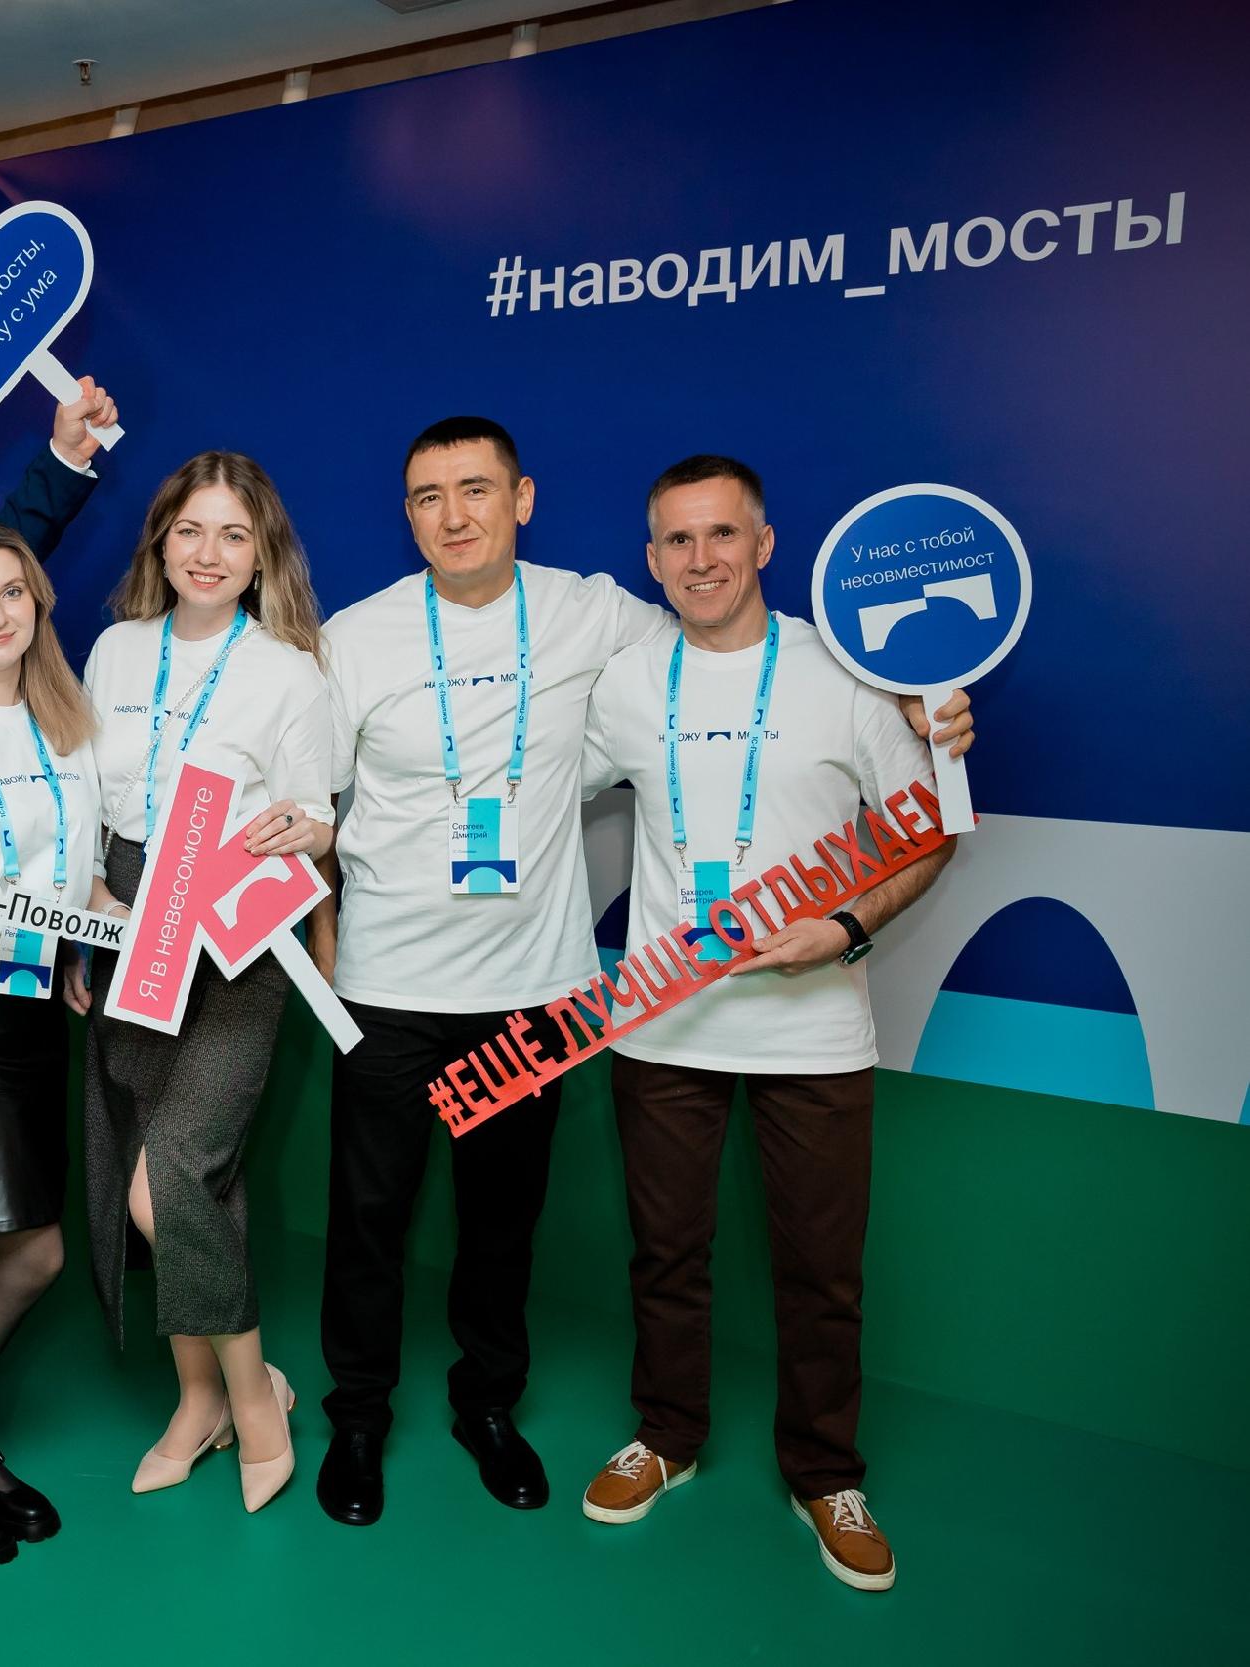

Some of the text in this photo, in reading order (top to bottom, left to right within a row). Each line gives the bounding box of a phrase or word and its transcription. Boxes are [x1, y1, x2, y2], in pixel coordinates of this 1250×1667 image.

[486, 191, 1186, 317] #наводим_мосты
[10, 307, 24, 322] с
[20, 269, 58, 313] ума
[851, 526, 975, 562] У нас с тобой
[840, 552, 995, 590] несовместимост
[424, 677, 468, 689] НАОЖУ
[113, 705, 149, 714] НАВОЖУ
[658, 730, 779, 743] НОЖУ МТЫ
[452, 831, 488, 841] Дмитрий
[139, 787, 213, 1002] Я в невесомосте
[428, 1010, 556, 1138] #ЕЩЁ
[544, 920, 723, 1058] ЛУЧШЕ
